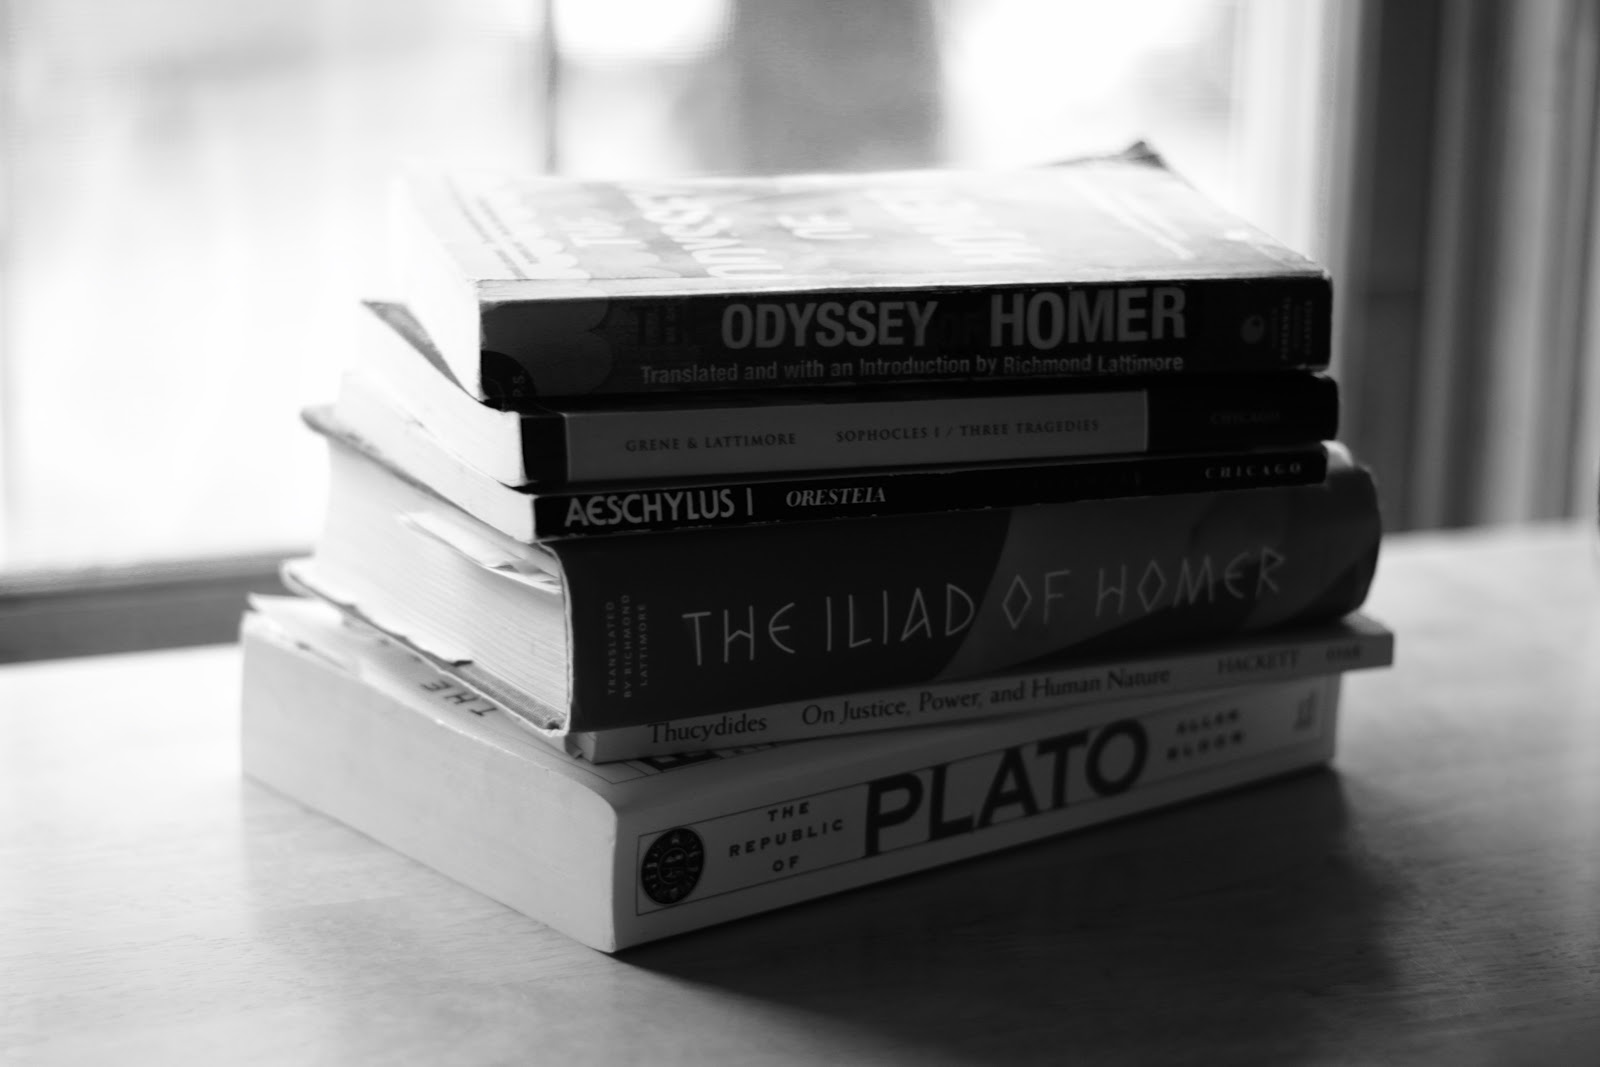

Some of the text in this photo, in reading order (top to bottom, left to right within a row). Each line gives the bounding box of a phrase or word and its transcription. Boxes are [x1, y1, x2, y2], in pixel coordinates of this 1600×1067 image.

[721, 299, 939, 350] ODYSSEY
[989, 287, 1187, 351] HOMER
[641, 353, 1184, 385] Translated and with an Introduction by Richmond Lattimore
[626, 438, 681, 453] GRENE
[687, 437, 698, 450] &
[705, 432, 797, 449] LATTIMORE
[836, 426, 928, 443] SOPHOCLES
[961, 423, 1008, 438] THREE
[1017, 418, 1099, 436] TRAGEDIES
[564, 486, 736, 528] AESCHYLUS
[785, 485, 888, 508] ORESTEIA
[1204, 460, 1304, 480] CHICAGO
[681, 545, 1287, 667] THE ILIAD OF HOMER
[605, 601, 617, 696] TRANSLATED
[620, 594, 633, 699] BY RICHMOND
[636, 603, 648, 687] LATTIMORE
[420, 680, 499, 717] THE
[647, 711, 768, 745] Thucydides
[801, 704, 835, 726] On
[839, 699, 912, 726] Justice,
[990, 682, 1026, 705] and
[1031, 676, 1101, 698] Human
[1106, 666, 1171, 690] Nature
[767, 801, 810, 823] THE
[863, 718, 1148, 859] PLATO
[729, 817, 844, 857] REPUBLIC
[772, 855, 800, 873] OF
